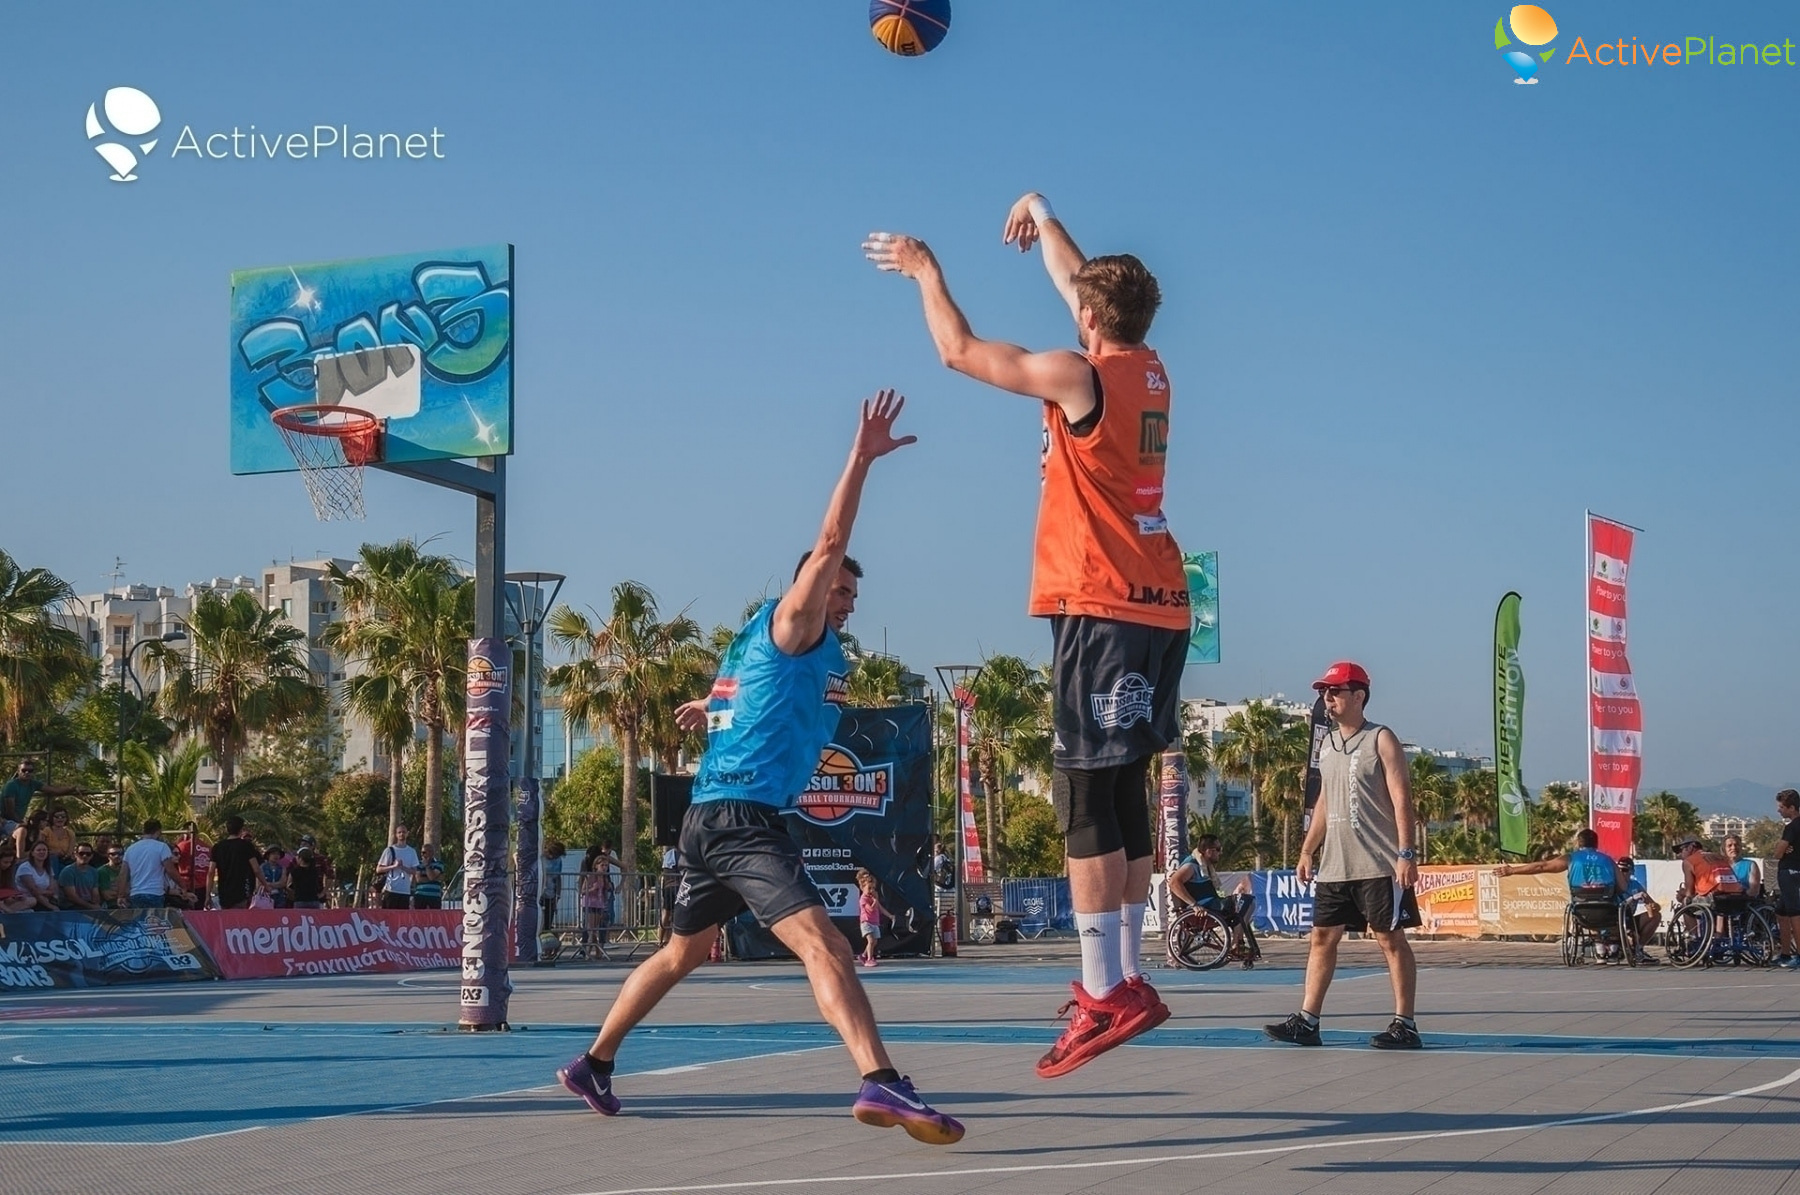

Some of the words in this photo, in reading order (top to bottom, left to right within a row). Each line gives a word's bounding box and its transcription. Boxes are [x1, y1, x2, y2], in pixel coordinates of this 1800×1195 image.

[1611, 650, 1622, 660] yo
[1618, 706, 1633, 716] you
[843, 770, 886, 794] 3ON3
[823, 794, 878, 806] TOURNAMENT
[1482, 887, 1497, 900] MA
[1517, 887, 1530, 897] THE
[1482, 901, 1497, 913] LL
[1502, 901, 1537, 910] SHOPPING
[1282, 903, 1314, 926] ME
